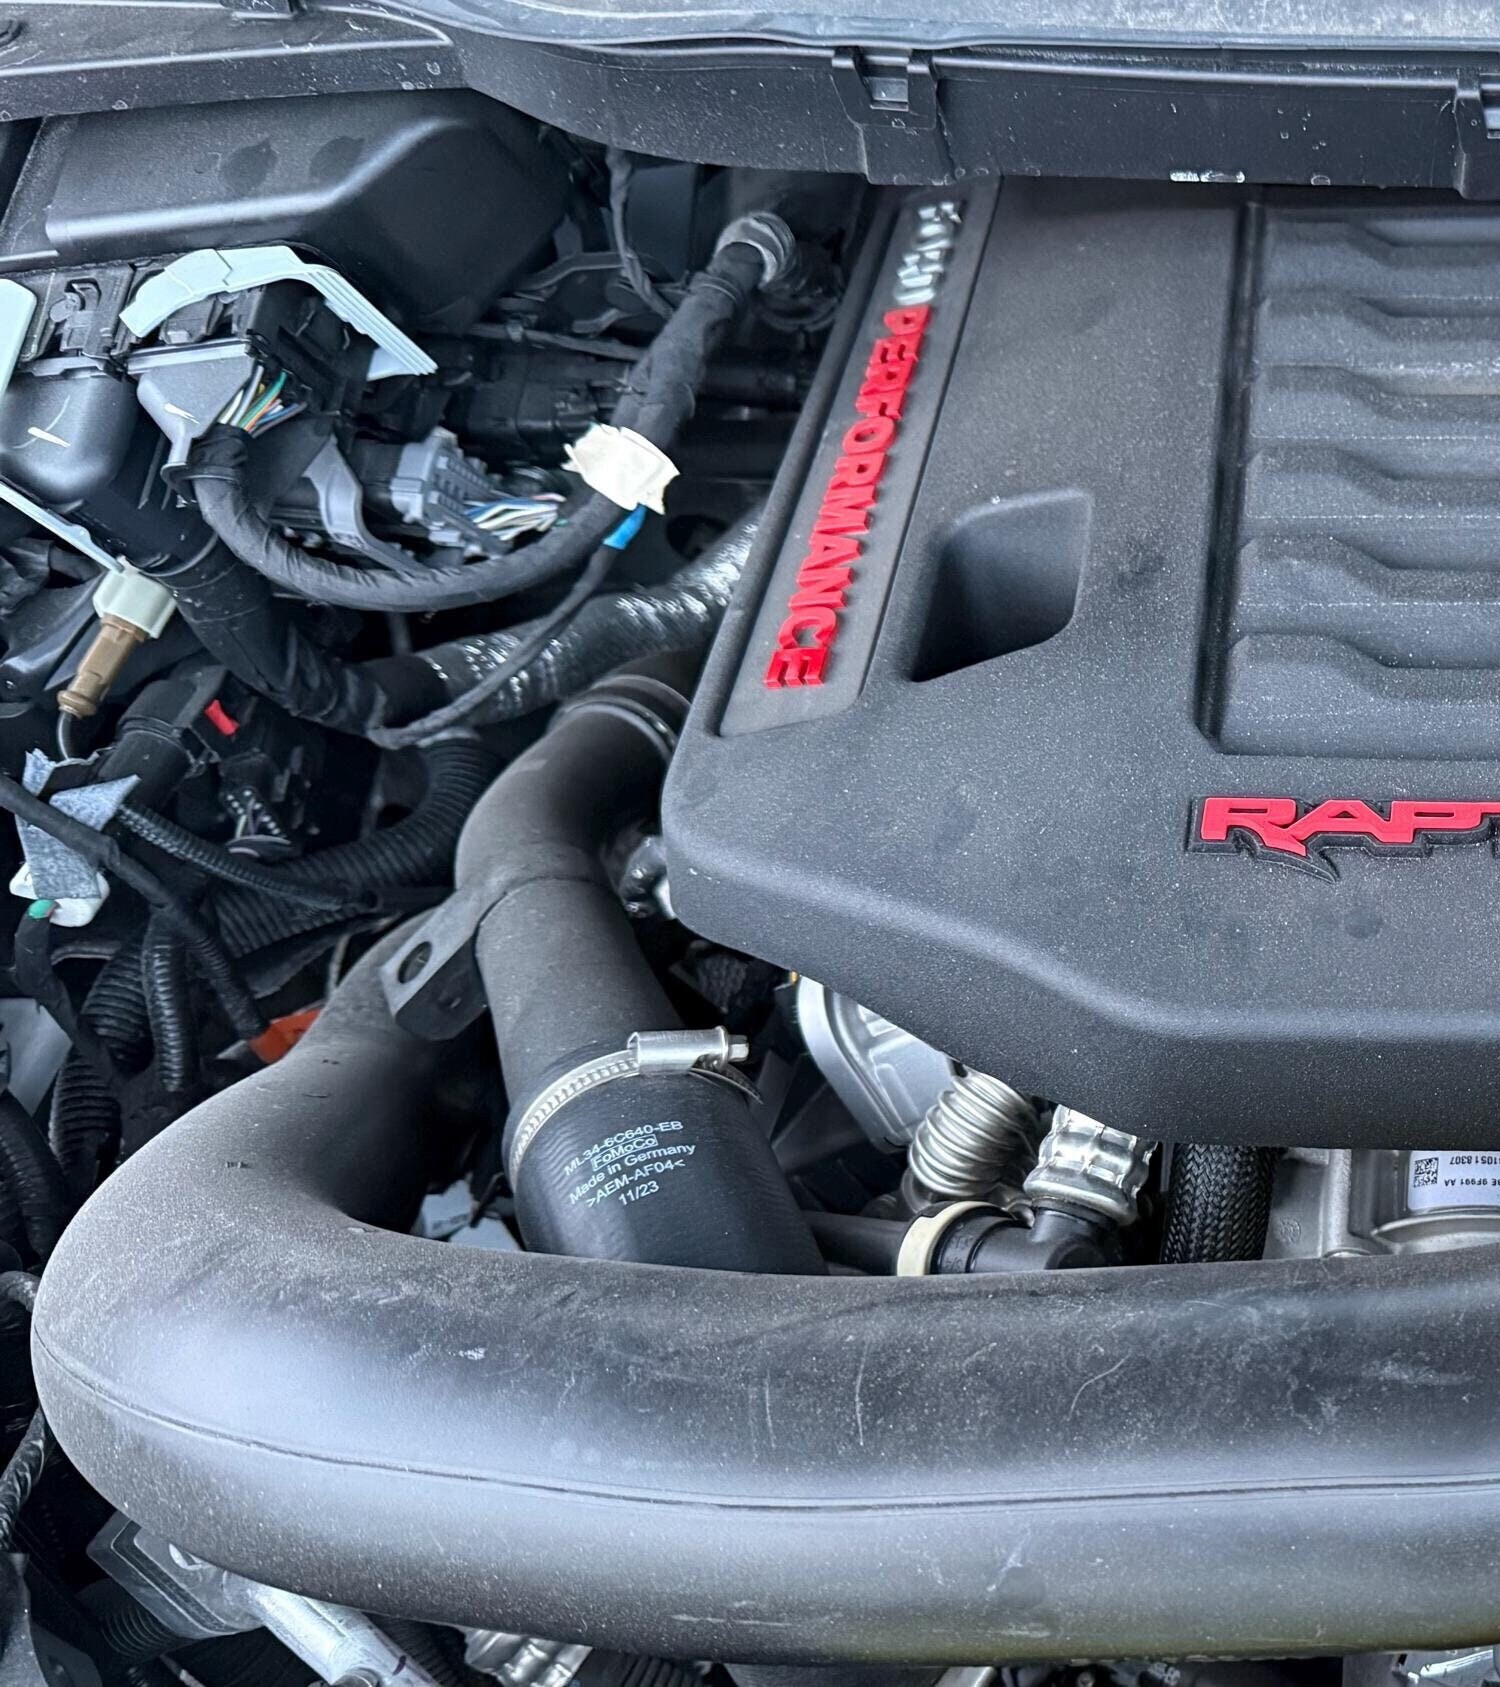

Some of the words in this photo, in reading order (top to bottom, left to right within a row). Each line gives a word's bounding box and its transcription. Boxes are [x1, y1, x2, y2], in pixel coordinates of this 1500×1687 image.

[764, 304, 932, 689] PERFORMANCE
[564, 1121, 683, 1176] ML34-6C640-EB
[569, 1172, 605, 1205] Made
[607, 1162, 622, 1175] in
[624, 1144, 696, 1167] Germany
[592, 1136, 658, 1170] FoMoCo
[619, 1180, 660, 1206] 11/23
